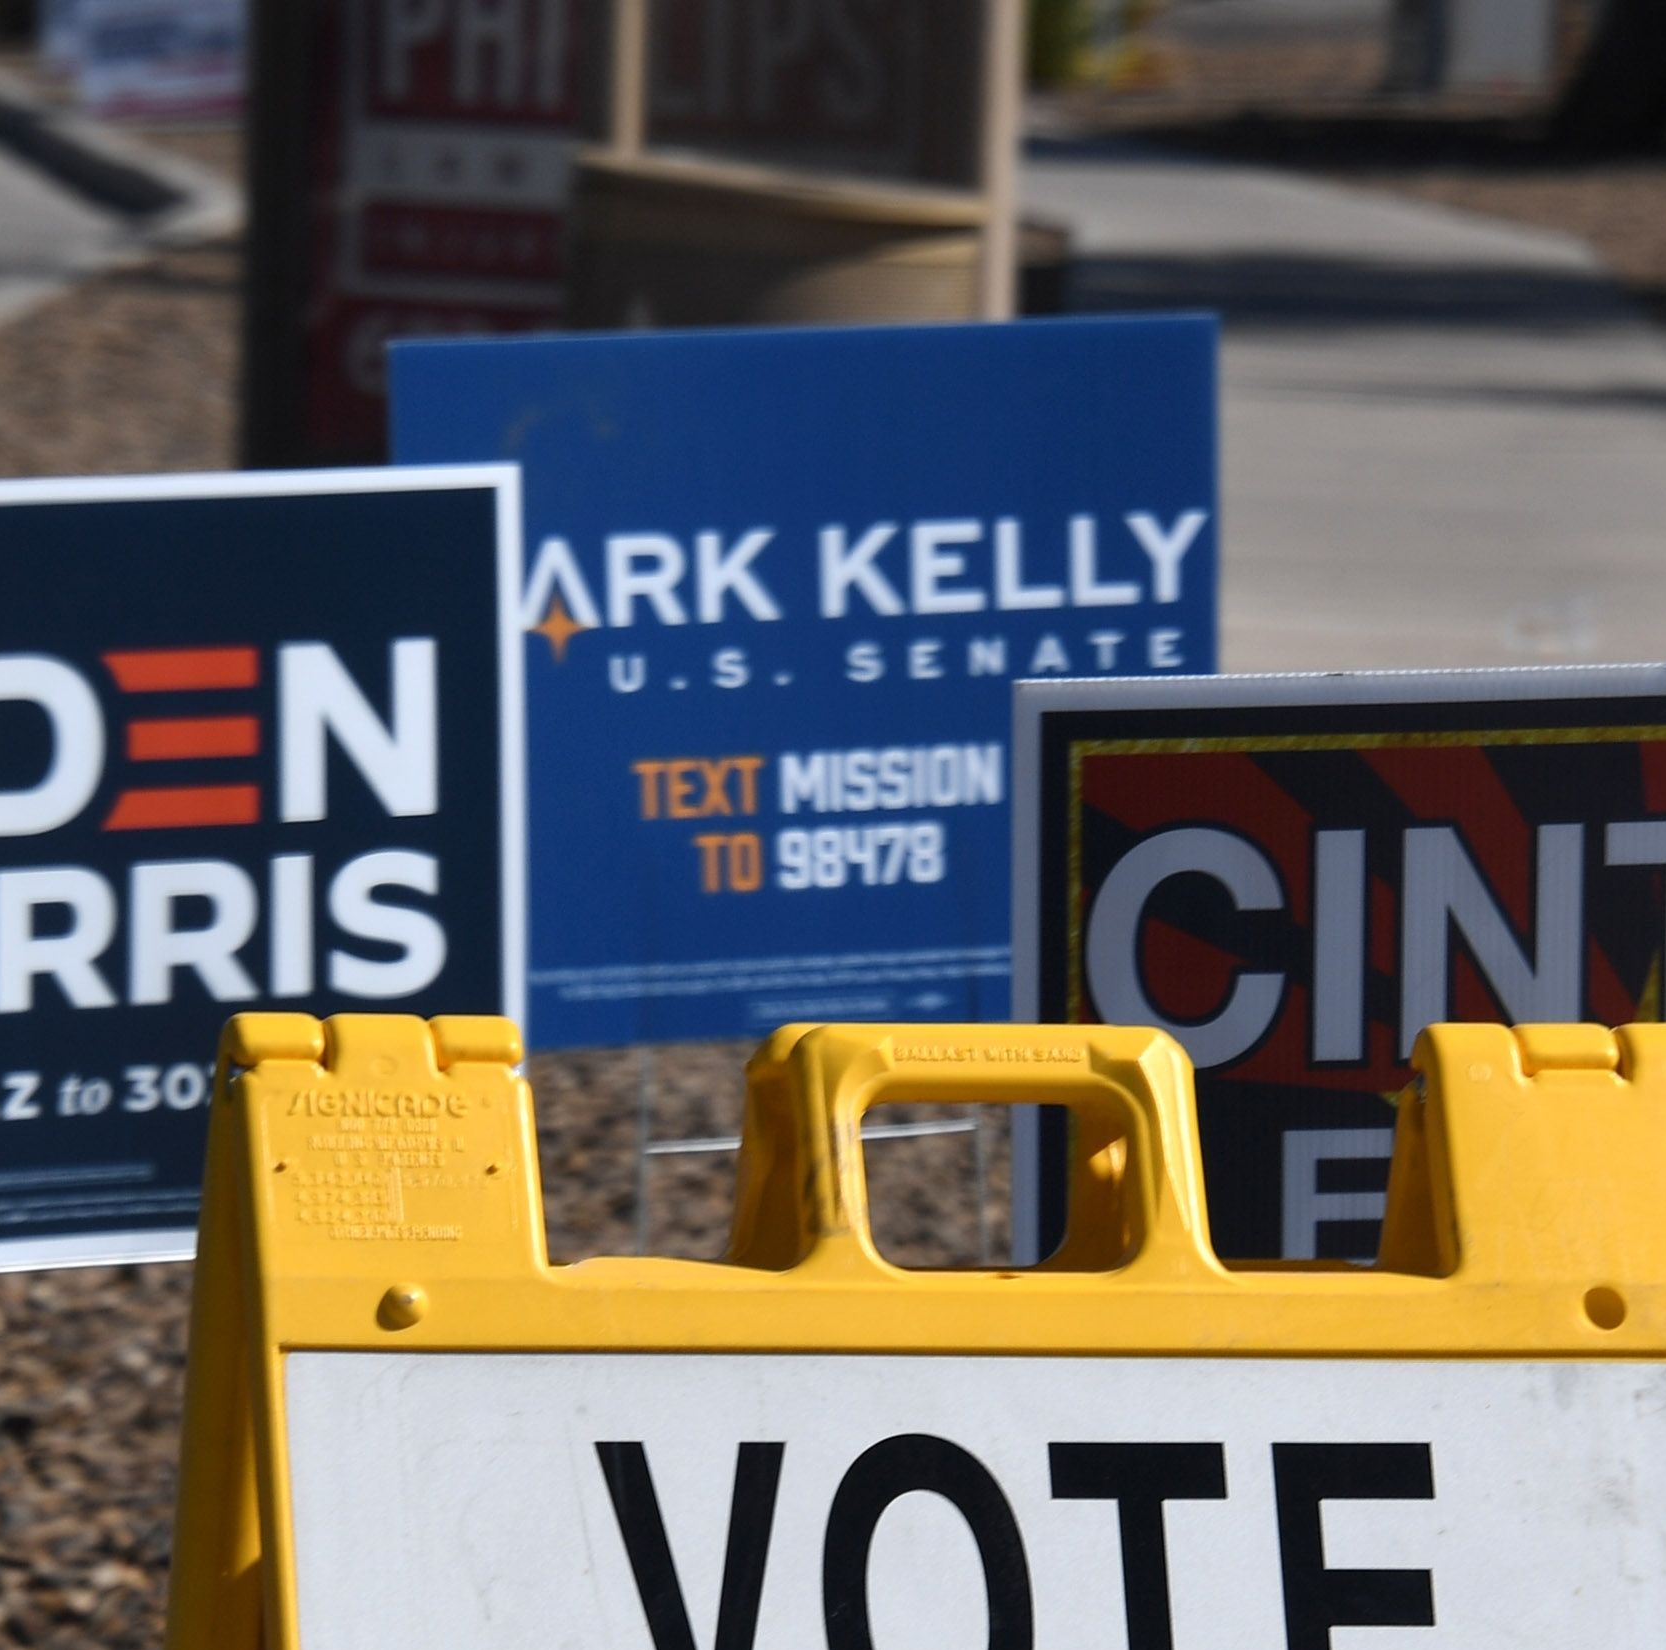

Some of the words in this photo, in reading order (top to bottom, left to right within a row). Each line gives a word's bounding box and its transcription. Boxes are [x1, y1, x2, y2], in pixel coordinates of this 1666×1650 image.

[522, 528, 782, 630] ARK
[820, 510, 1208, 616] KELLY
[609, 648, 792, 694] U.S.
[846, 627, 1185, 682] SENATE
[634, 755, 765, 820] TEXT
[780, 743, 1005, 814] MISSION
[694, 832, 763, 893] TO
[778, 819, 945, 889] 98478
[56, 1074, 112, 1116] to
